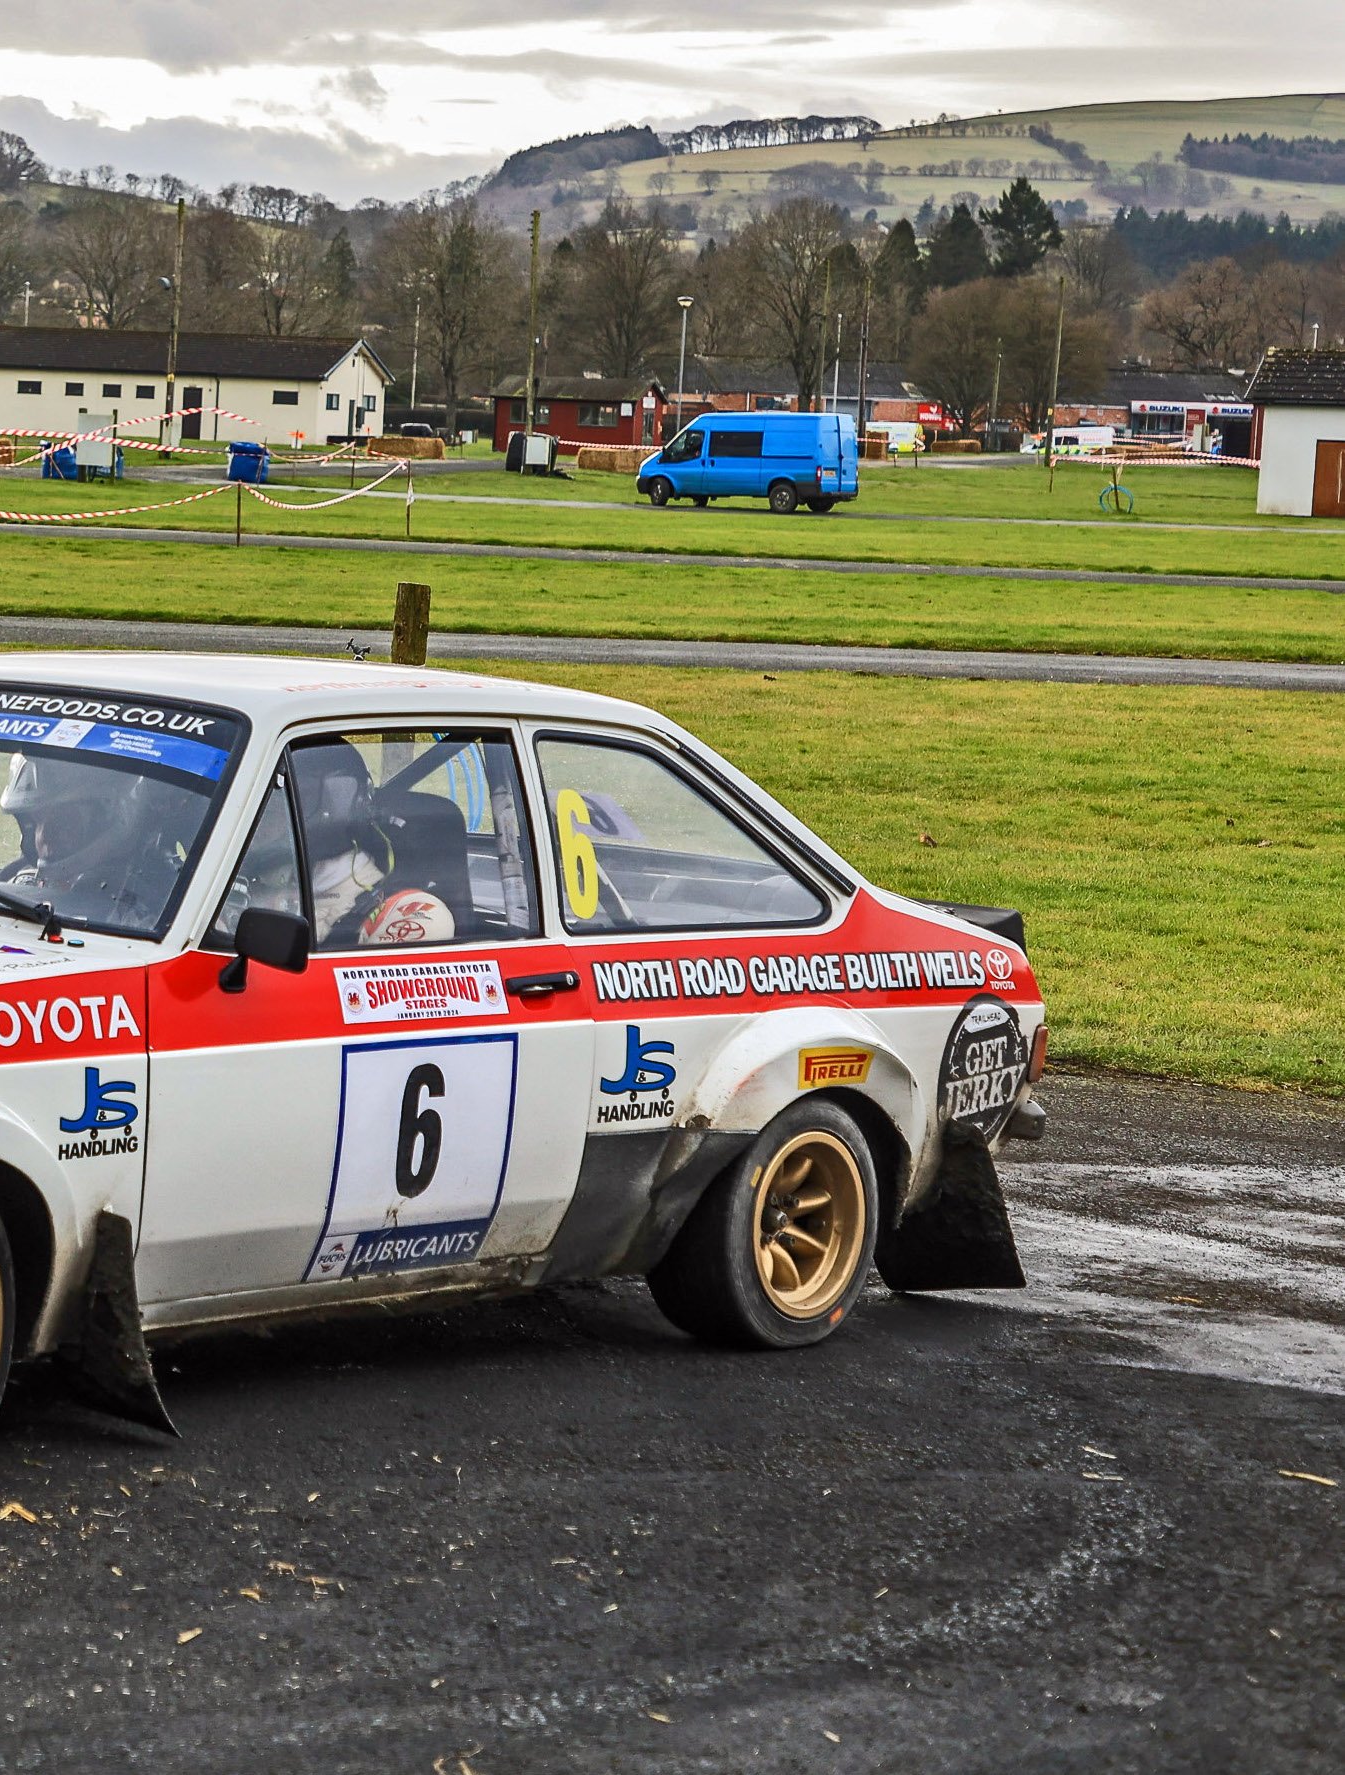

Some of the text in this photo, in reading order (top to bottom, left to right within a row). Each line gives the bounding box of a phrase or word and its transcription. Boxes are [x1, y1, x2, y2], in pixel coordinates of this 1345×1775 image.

[1149, 405, 1184, 413] SUZUKI
[556, 788, 599, 920] 6
[343, 963, 492, 980] NORTH ROAD GARAGE TOYOTA
[592, 950, 985, 1000] NORTH ROAD GARAGE BUILTH WELLS
[365, 975, 480, 1010] SHOWGROUND
[989, 980, 1016, 991] TOYOTA
[397, 1010, 425, 1020] JANUARY
[405, 998, 448, 1010] STAGES
[804, 1053, 868, 1082] PIRELLI
[965, 1036, 1008, 1076] GET
[938, 1062, 1027, 1122] JERKY
[597, 1100, 675, 1124] HANDLING
[395, 1062, 446, 1199] 6
[58, 1136, 139, 1161] HANDLING
[317, 1252, 347, 1265] FUCHS
[351, 1231, 481, 1267] LUBRICANTS
